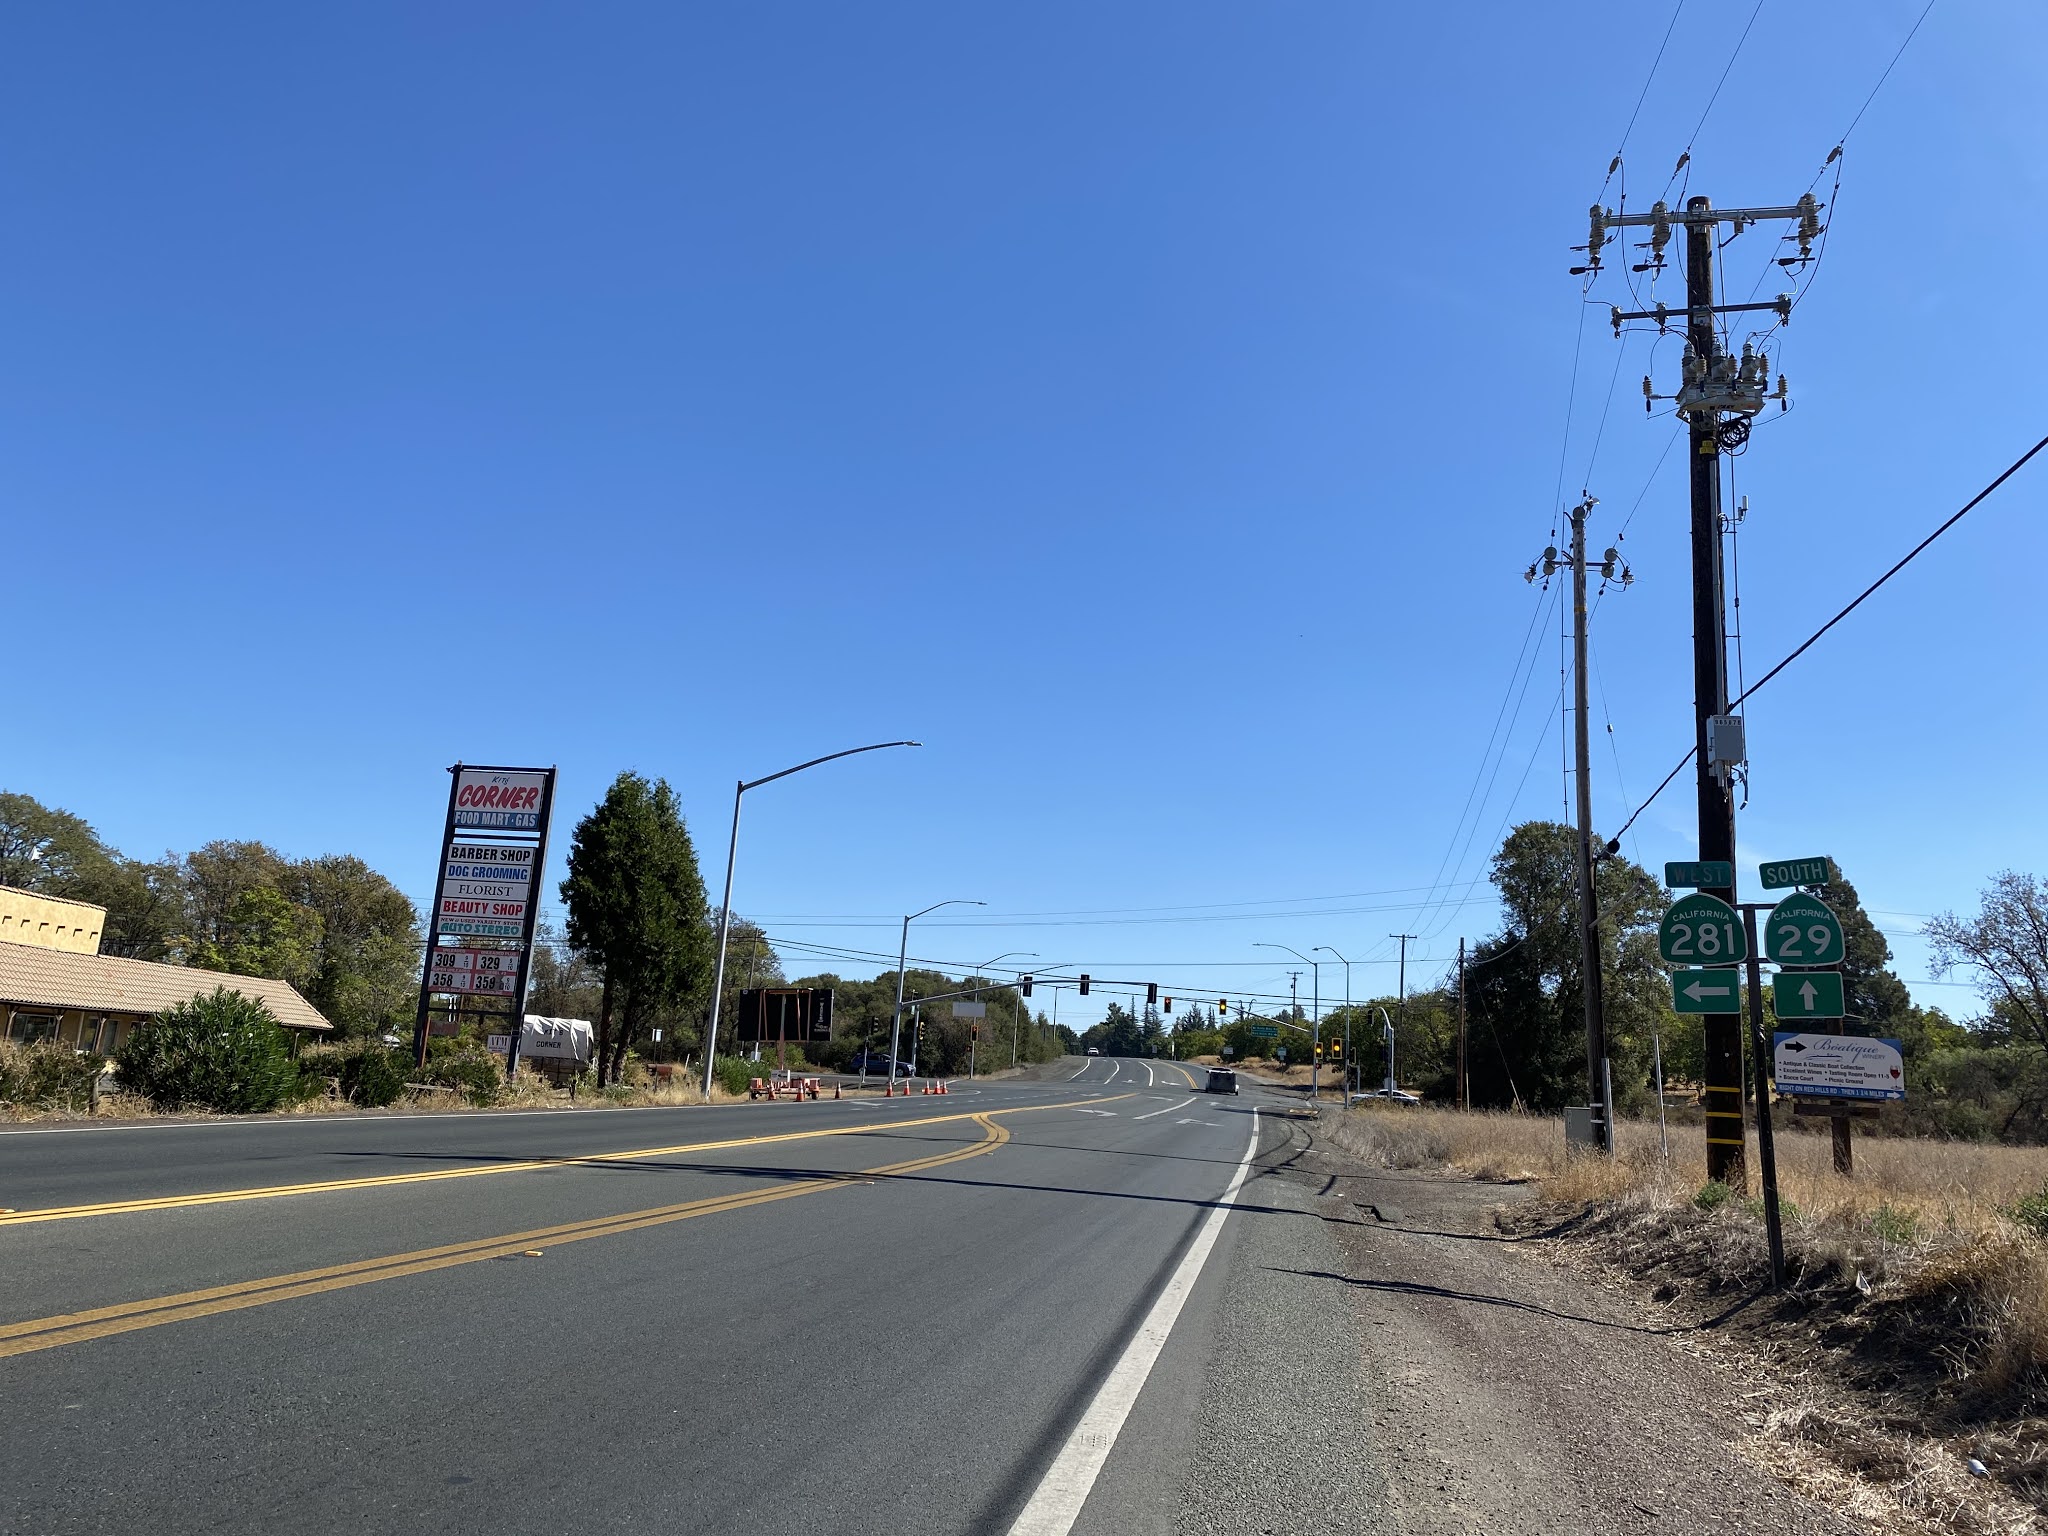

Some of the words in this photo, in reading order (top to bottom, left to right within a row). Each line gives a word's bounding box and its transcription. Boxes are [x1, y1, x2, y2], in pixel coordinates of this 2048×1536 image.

[458, 784, 539, 809] CORNER
[454, 811, 480, 824] FOOD
[481, 812, 511, 825] MART
[515, 813, 536, 827] GAS
[451, 847, 498, 860] BARBER
[500, 849, 531, 861] SHOP
[448, 865, 469, 876] DOG
[471, 867, 528, 880] GROOMING
[1674, 866, 1723, 883] WEST
[1766, 862, 1823, 884] SOUTH
[458, 884, 514, 897] FLORIST
[443, 901, 489, 914] BEAUTY
[492, 904, 523, 916] SHOP
[1672, 910, 1730, 922] CALIFORNIA
[1773, 908, 1831, 921] CALIFORNIA
[441, 922, 473, 933] AUTO
[474, 924, 520, 935] STEREO
[1669, 923, 1735, 956] 281
[1777, 924, 1832, 957] 29
[435, 953, 456, 967] 309
[480, 956, 500, 970] 329
[433, 972, 453, 987] 358
[475, 975, 496, 989] 359
[535, 1040, 561, 1049] CORNER
[1813, 1039, 1879, 1063] Boatique
